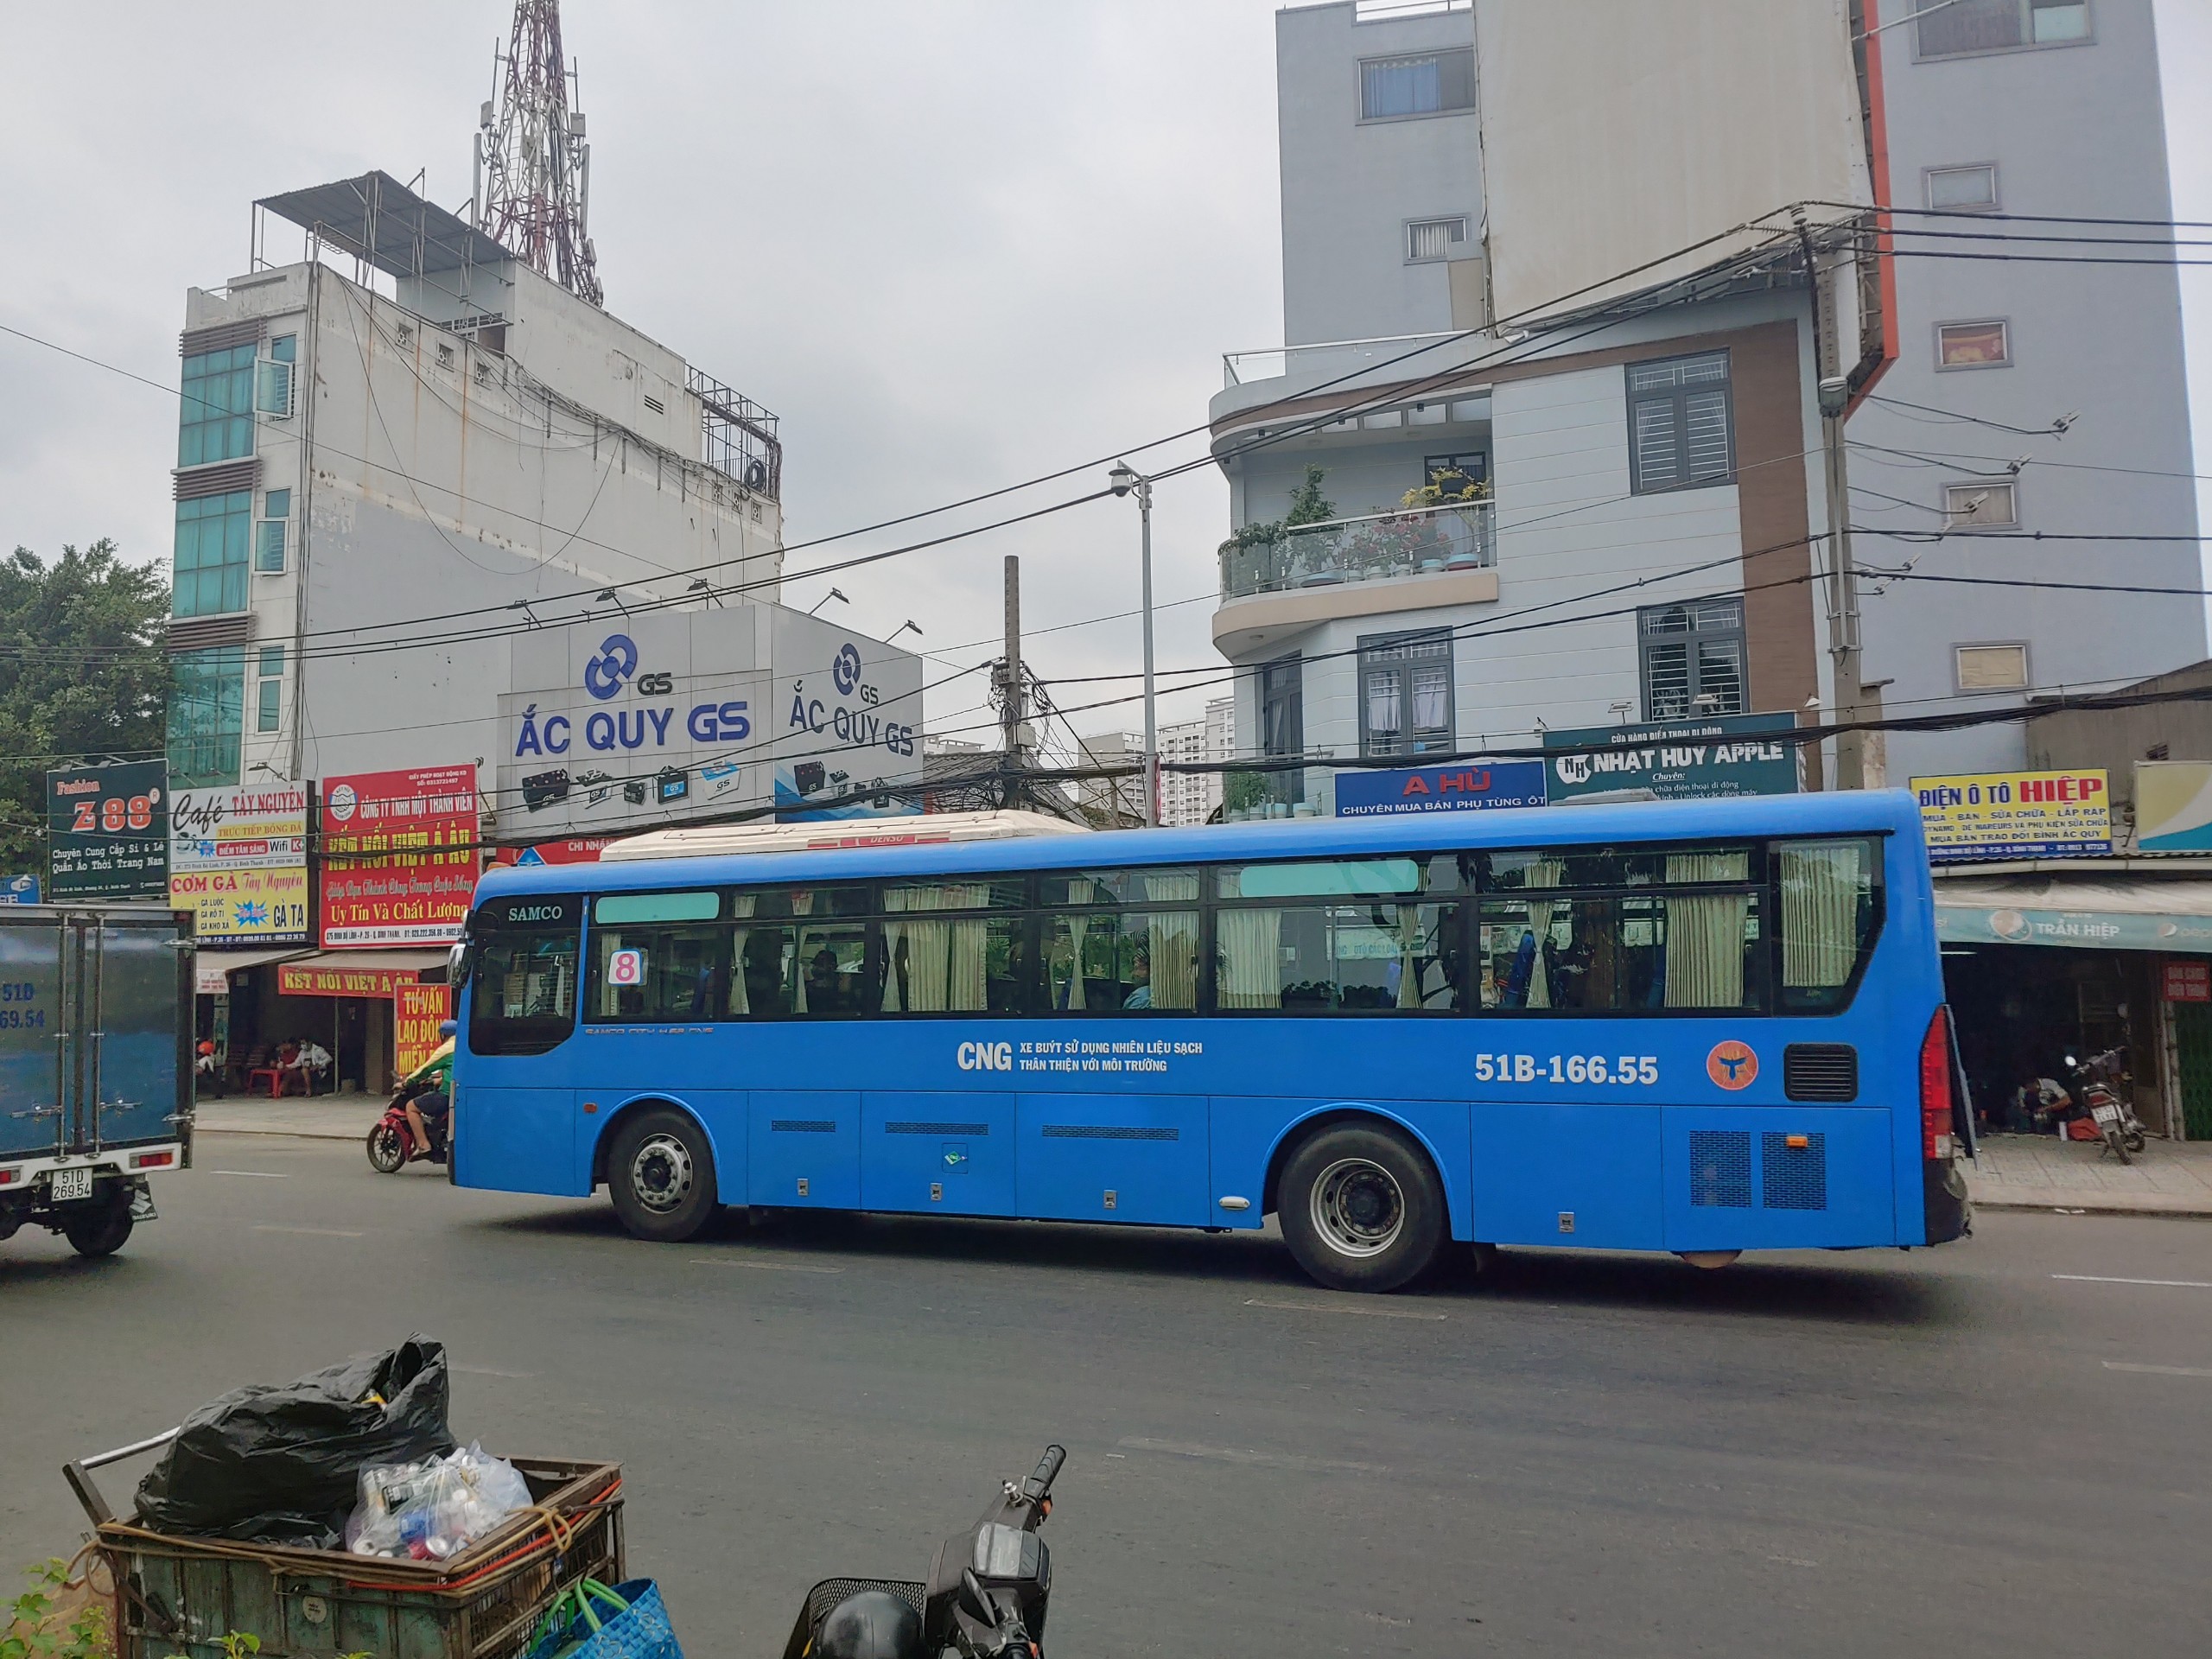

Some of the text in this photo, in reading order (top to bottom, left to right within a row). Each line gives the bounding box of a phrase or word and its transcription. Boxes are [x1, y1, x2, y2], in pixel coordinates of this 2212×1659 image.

[638, 672, 672, 696] GS
[860, 684, 879, 705] GS
[515, 701, 750, 757] ẮC QUY GS
[790, 679, 913, 757] ẮC QUY GS
[1661, 745, 1707, 767] HUY
[1714, 741, 1784, 763] APPLE
[57, 779, 100, 795] Fashion
[716, 779, 730, 789] GS
[1402, 767, 1491, 796] A HÙ
[1652, 772, 1686, 782] Chuyên:
[1919, 776, 2102, 810] ĐIỆN Ô TÔ HIỆP
[173, 785, 305, 835] Café TÂY NGUYÊN
[361, 795, 379, 819] CÔNG
[380, 799, 389, 817] TY
[391, 796, 410, 817] TNHH
[1343, 804, 1393, 815] CHUYÊN
[1395, 803, 1421, 812] MUA
[1425, 800, 1452, 810] BÁN
[1457, 799, 1482, 810] PHỤ
[1486, 797, 1522, 806] TÙNG
[53, 848, 81, 860] Chuyên
[85, 847, 105, 857] Cung
[109, 843, 124, 856] Cấp
[270, 841, 288, 852] Wifi
[569, 842, 583, 852] CHI
[53, 860, 73, 874] Quần
[76, 859, 87, 870] Áo
[117, 859, 143, 869] Trang
[148, 857, 164, 867] Nam
[172, 873, 208, 895] CƠM
[213, 871, 238, 892] GÀ
[274, 899, 286, 928] GÀ
[290, 905, 304, 927] TA
[332, 899, 467, 925] Uy Tín Và Chất Lượng
[508, 906, 562, 921] SAMCO
[2036, 918, 2120, 940] TRẦN HIỆP
[615, 953, 635, 982] 8
[3, 982, 35, 1001] 51D
[284, 969, 391, 995] KẾT NỐI VIỆT Á
[404, 985, 443, 1014] TƯ VẤN
[397, 1019, 418, 1044] LAO
[957, 1041, 1012, 1071] CNG
[1020, 1039, 1203, 1056] XE BUÝT SỬ DỤNG NHIÊN LIỆU SẠCH
[1020, 1057, 1167, 1073] THÂN THIỆN VỚI MÔI TRƯỜNG
[1474, 1053, 1659, 1084] 51B-166.55
[62, 1170, 84, 1184] 51D
[54, 1182, 91, 1199] 269.54
